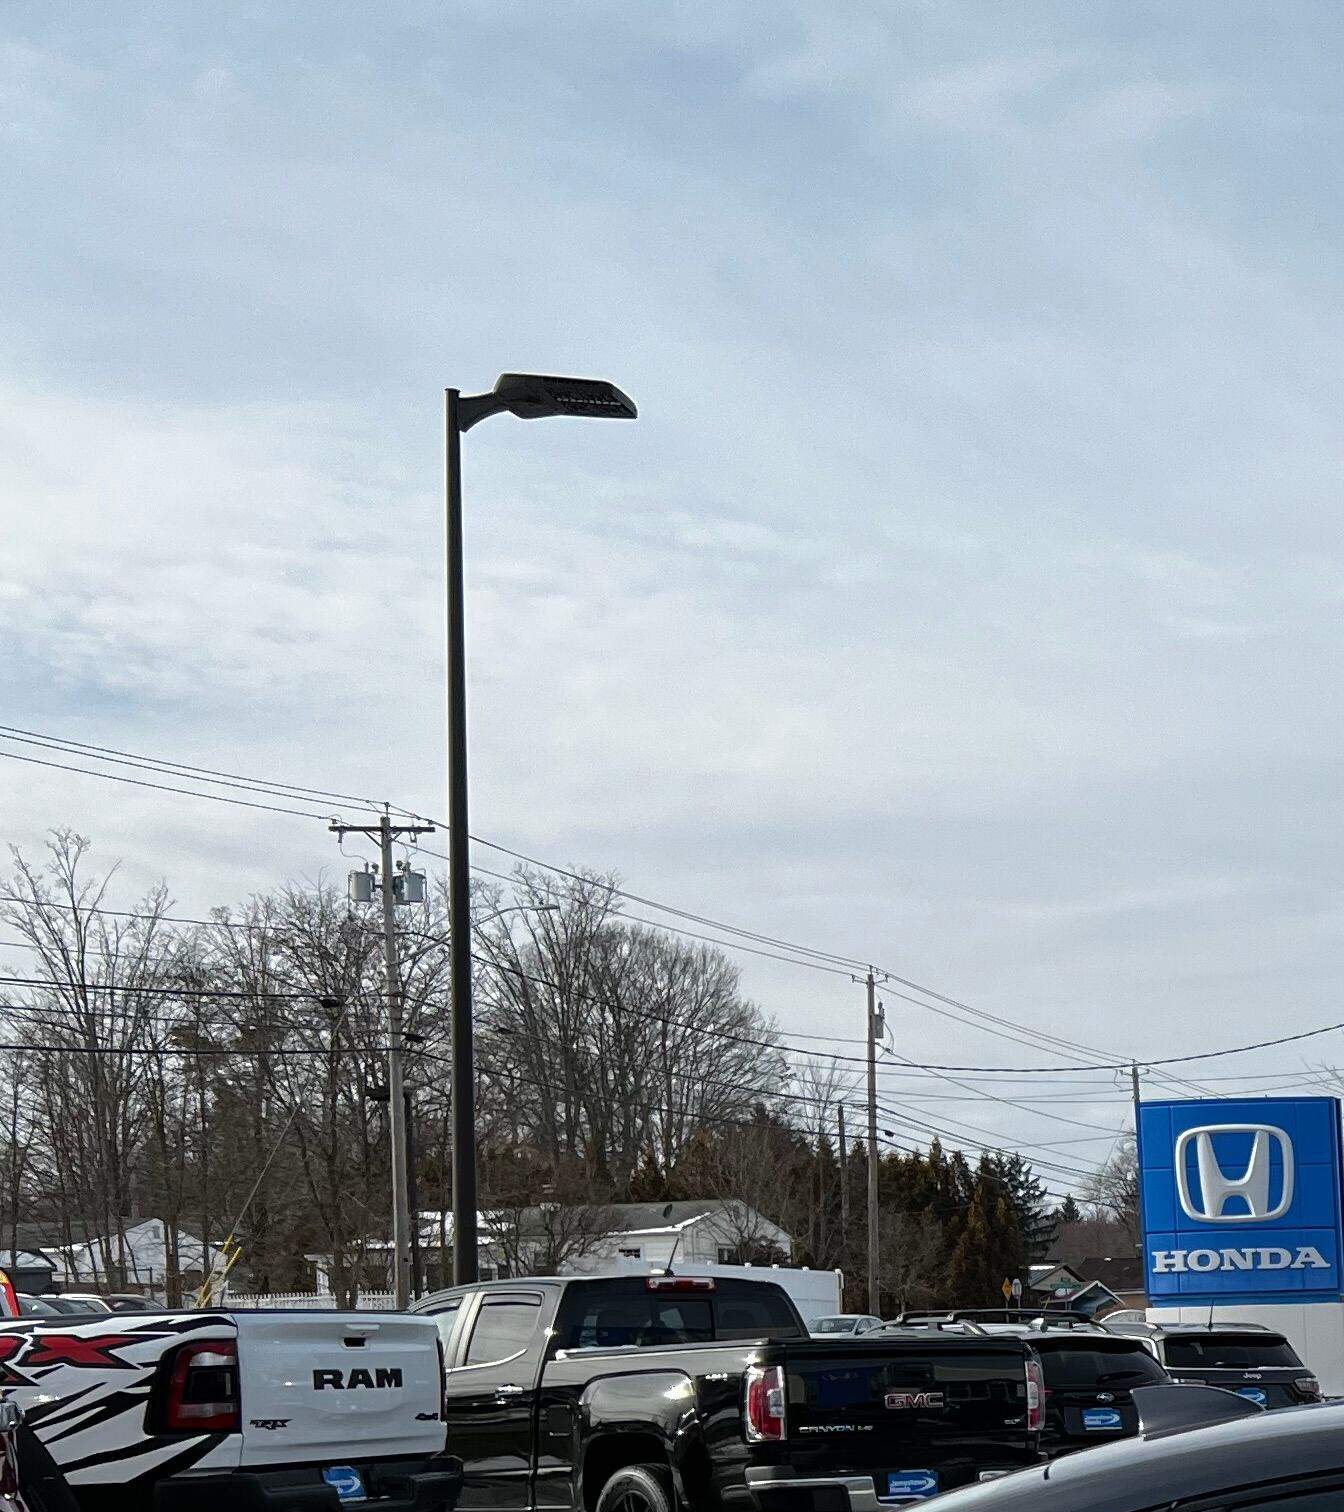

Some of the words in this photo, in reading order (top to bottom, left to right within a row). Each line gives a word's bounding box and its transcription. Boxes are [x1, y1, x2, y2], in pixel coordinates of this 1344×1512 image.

[1151, 1246, 1331, 1274] HONDA
[312, 1368, 403, 1390] RAM
[1242, 1372, 1262, 1380] Jeep
[884, 1392, 944, 1410] GMC
[798, 1424, 855, 1433] CANYON
